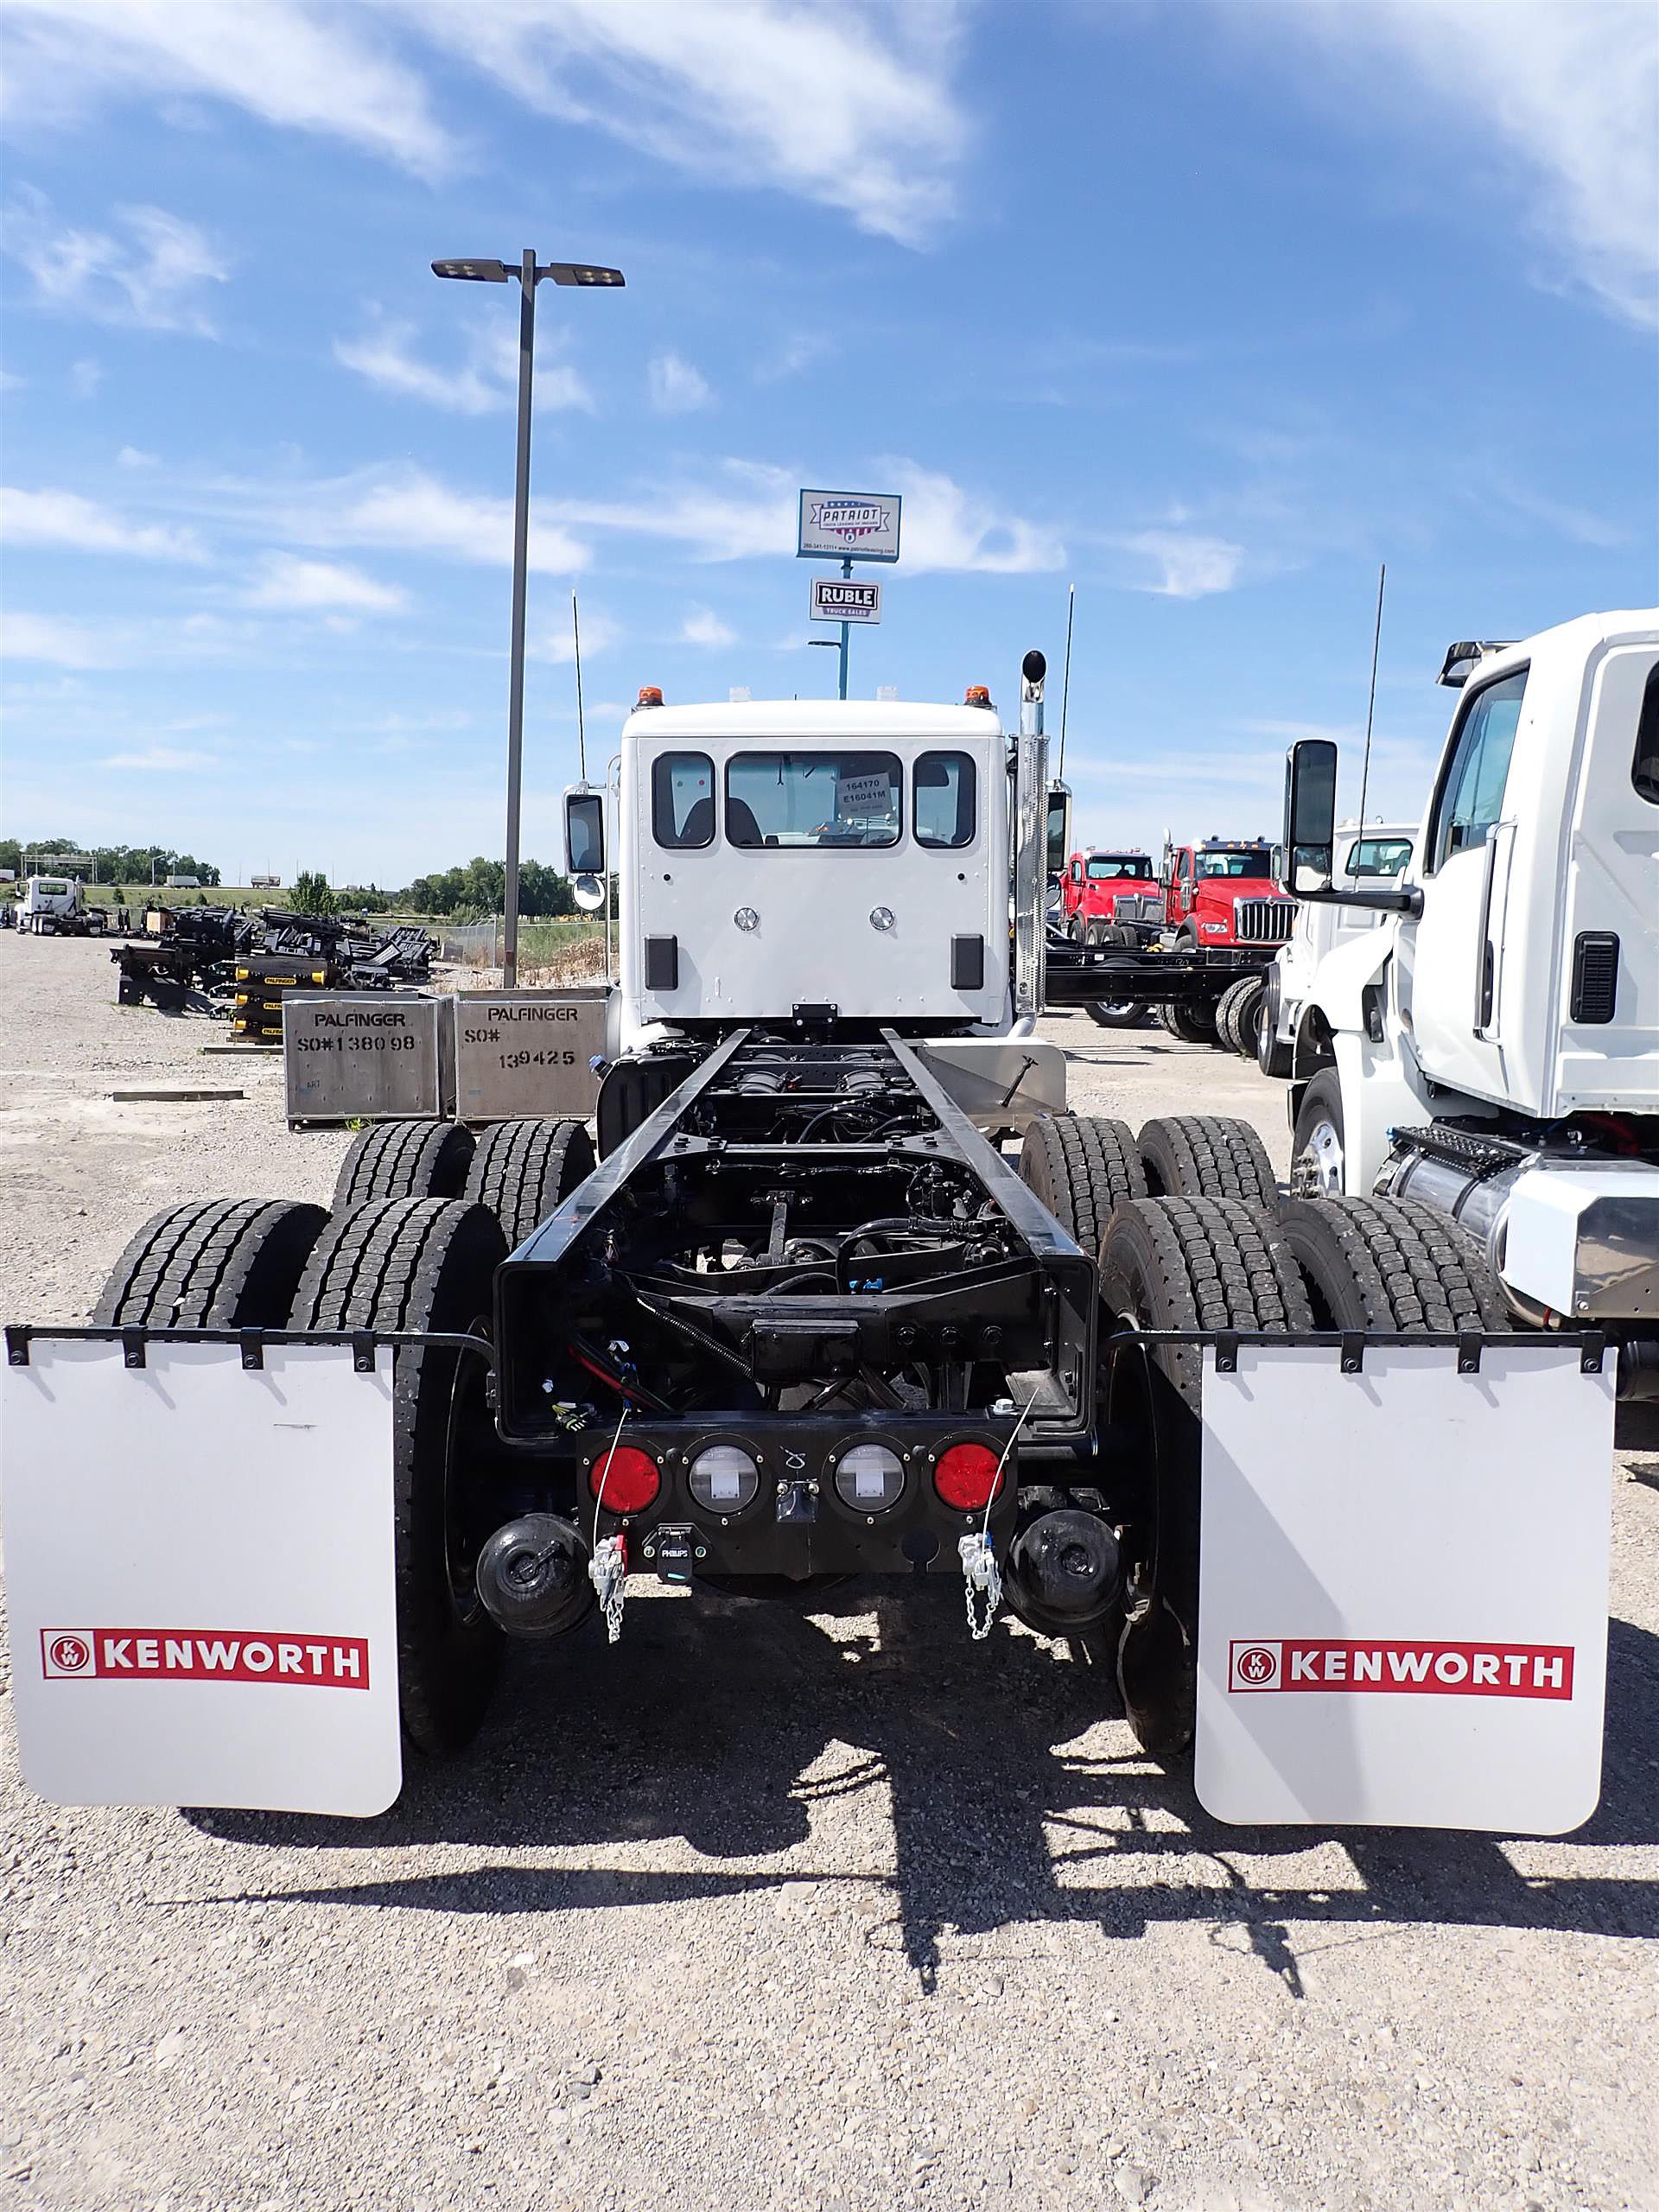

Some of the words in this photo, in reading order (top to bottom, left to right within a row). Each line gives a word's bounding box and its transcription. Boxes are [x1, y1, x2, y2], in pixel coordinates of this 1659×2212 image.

[823, 509, 879, 522] PATRIOT
[822, 587, 873, 605] RUBLE
[846, 779, 880, 791] 164170
[843, 791, 886, 803] E16041M
[487, 1007, 578, 1020] PALFINGER
[315, 1014, 406, 1027] PALFINGER
[105, 1639, 359, 1678] KENWORTH
[1291, 1651, 1563, 1688] KENWORTH
